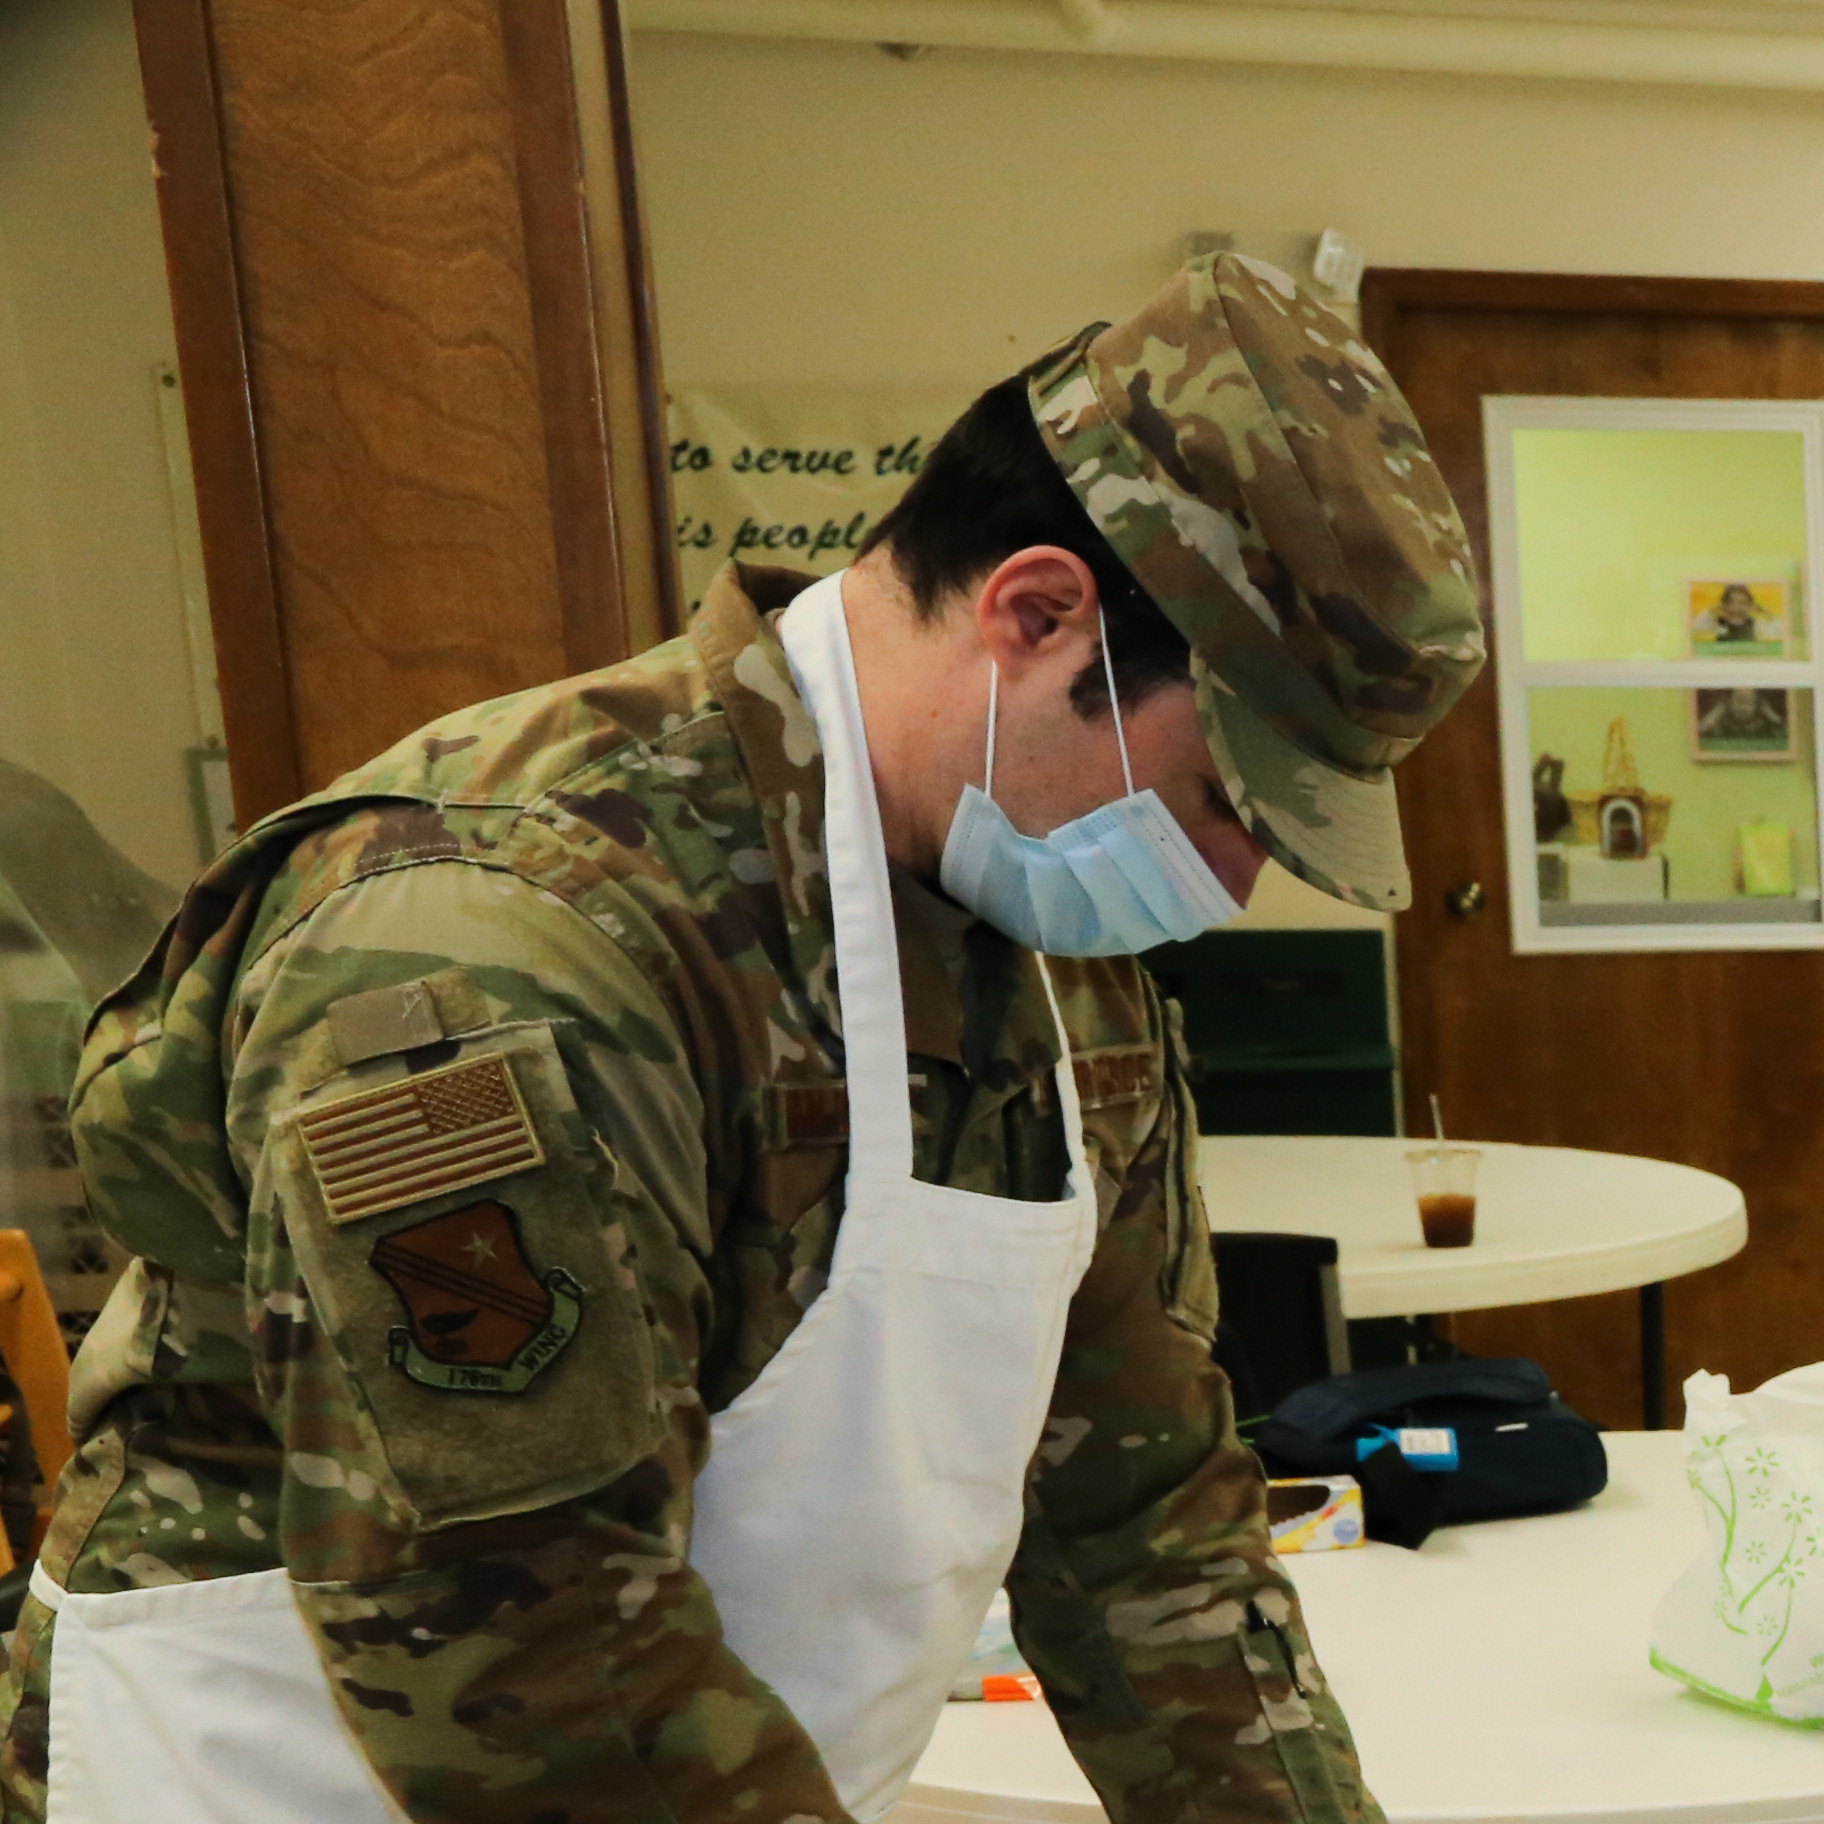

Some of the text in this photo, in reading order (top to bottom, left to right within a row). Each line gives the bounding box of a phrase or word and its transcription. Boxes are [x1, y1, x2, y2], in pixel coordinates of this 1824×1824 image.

[669, 435, 934, 476] to serve th
[728, 511, 868, 561] peopl
[517, 1324, 567, 1372] WING
